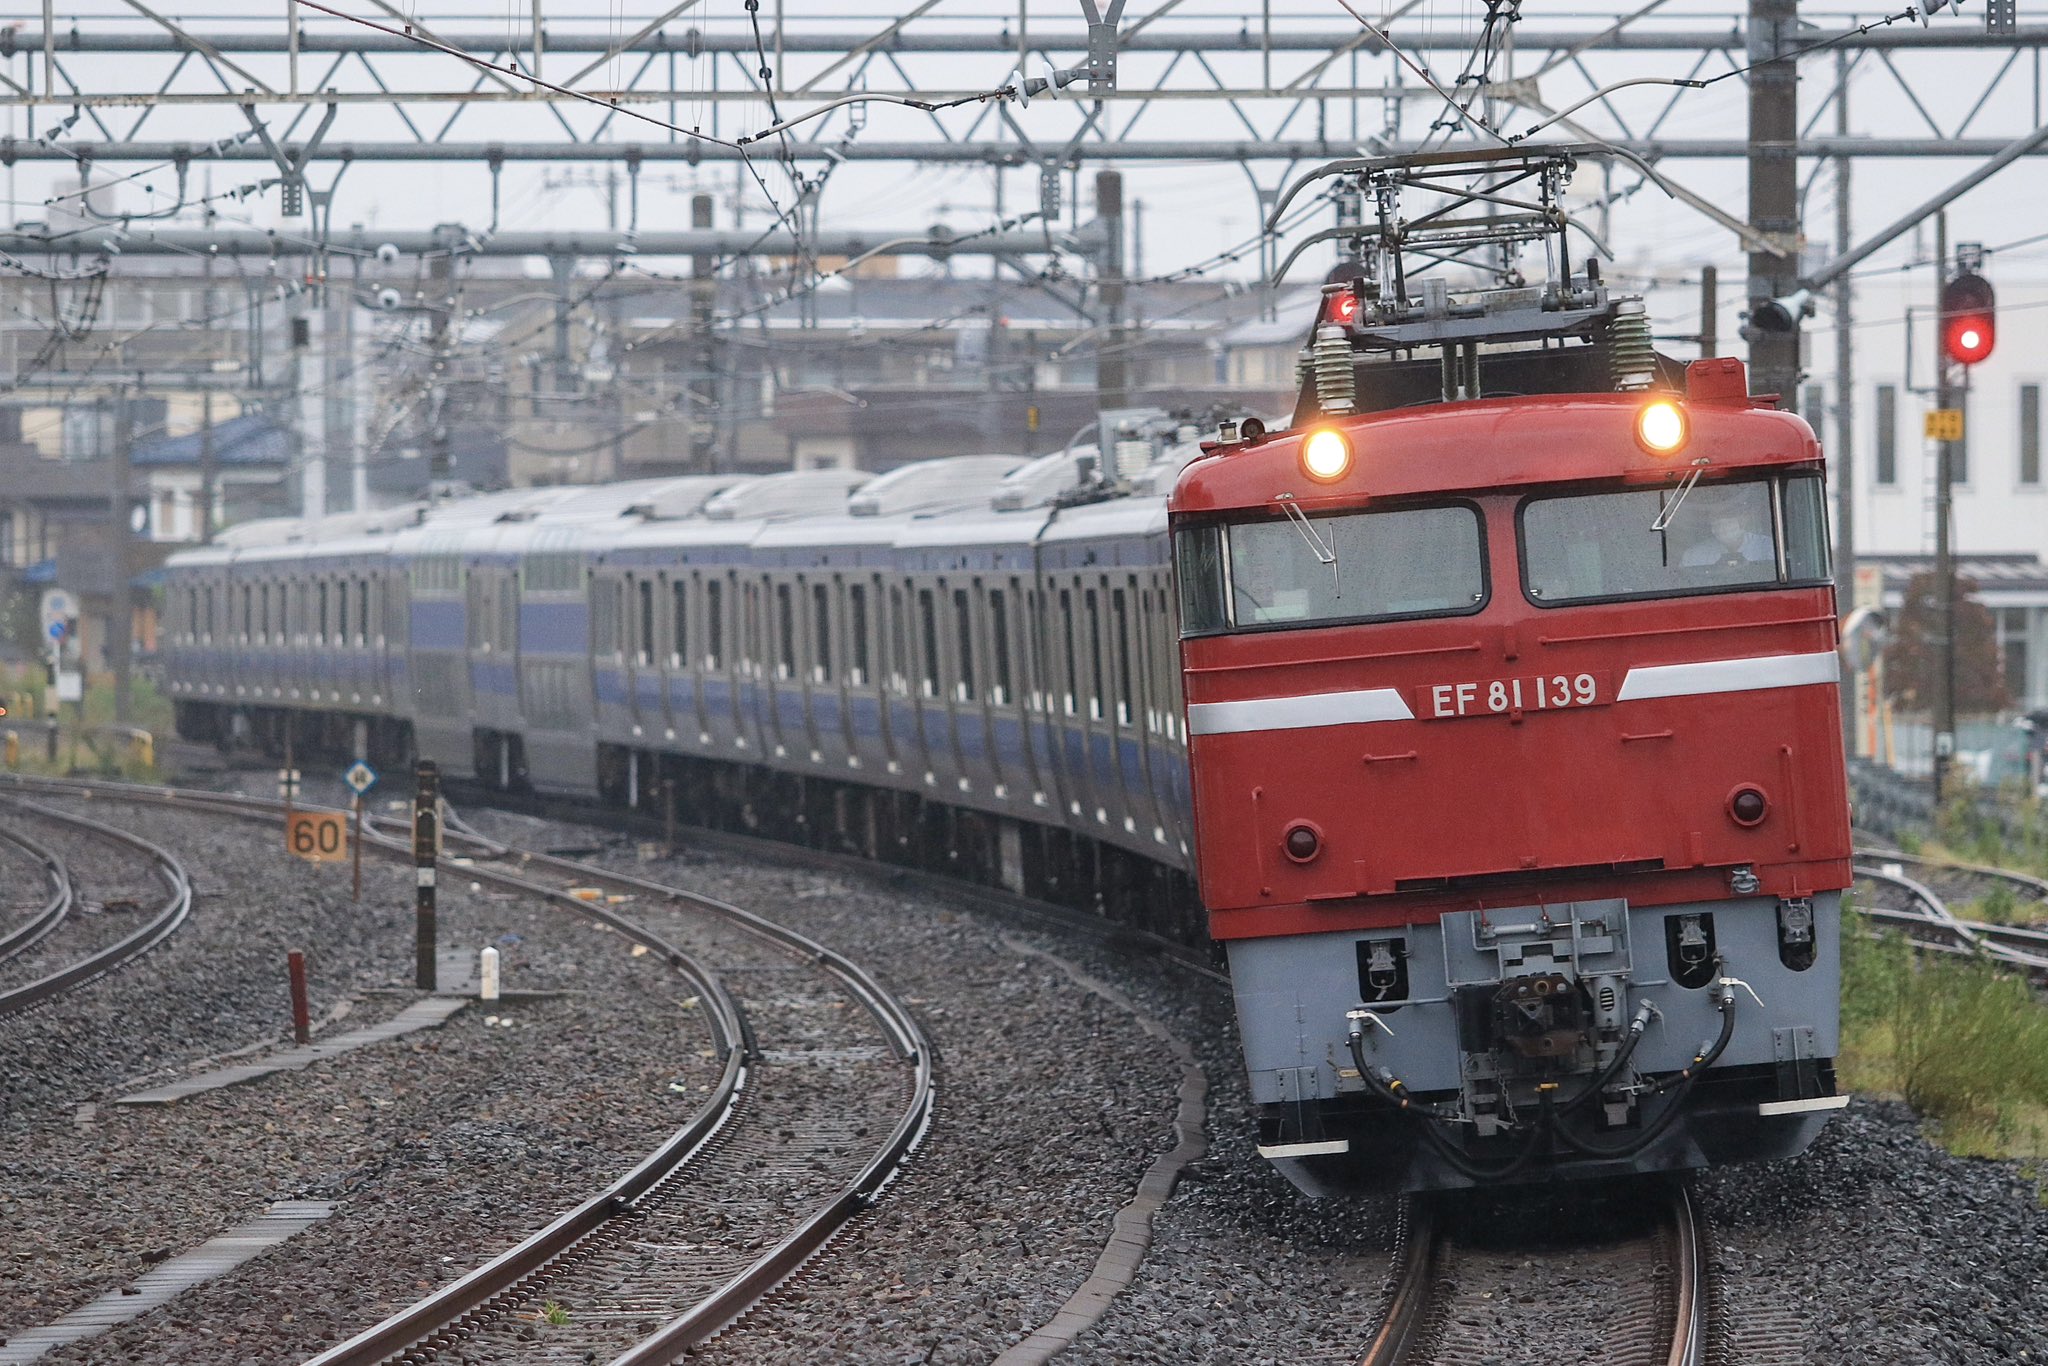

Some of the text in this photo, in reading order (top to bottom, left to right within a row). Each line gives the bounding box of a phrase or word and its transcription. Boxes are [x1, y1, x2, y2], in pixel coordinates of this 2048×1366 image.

[1432, 673, 1597, 717] EF 81 139
[295, 820, 339, 853] 60
